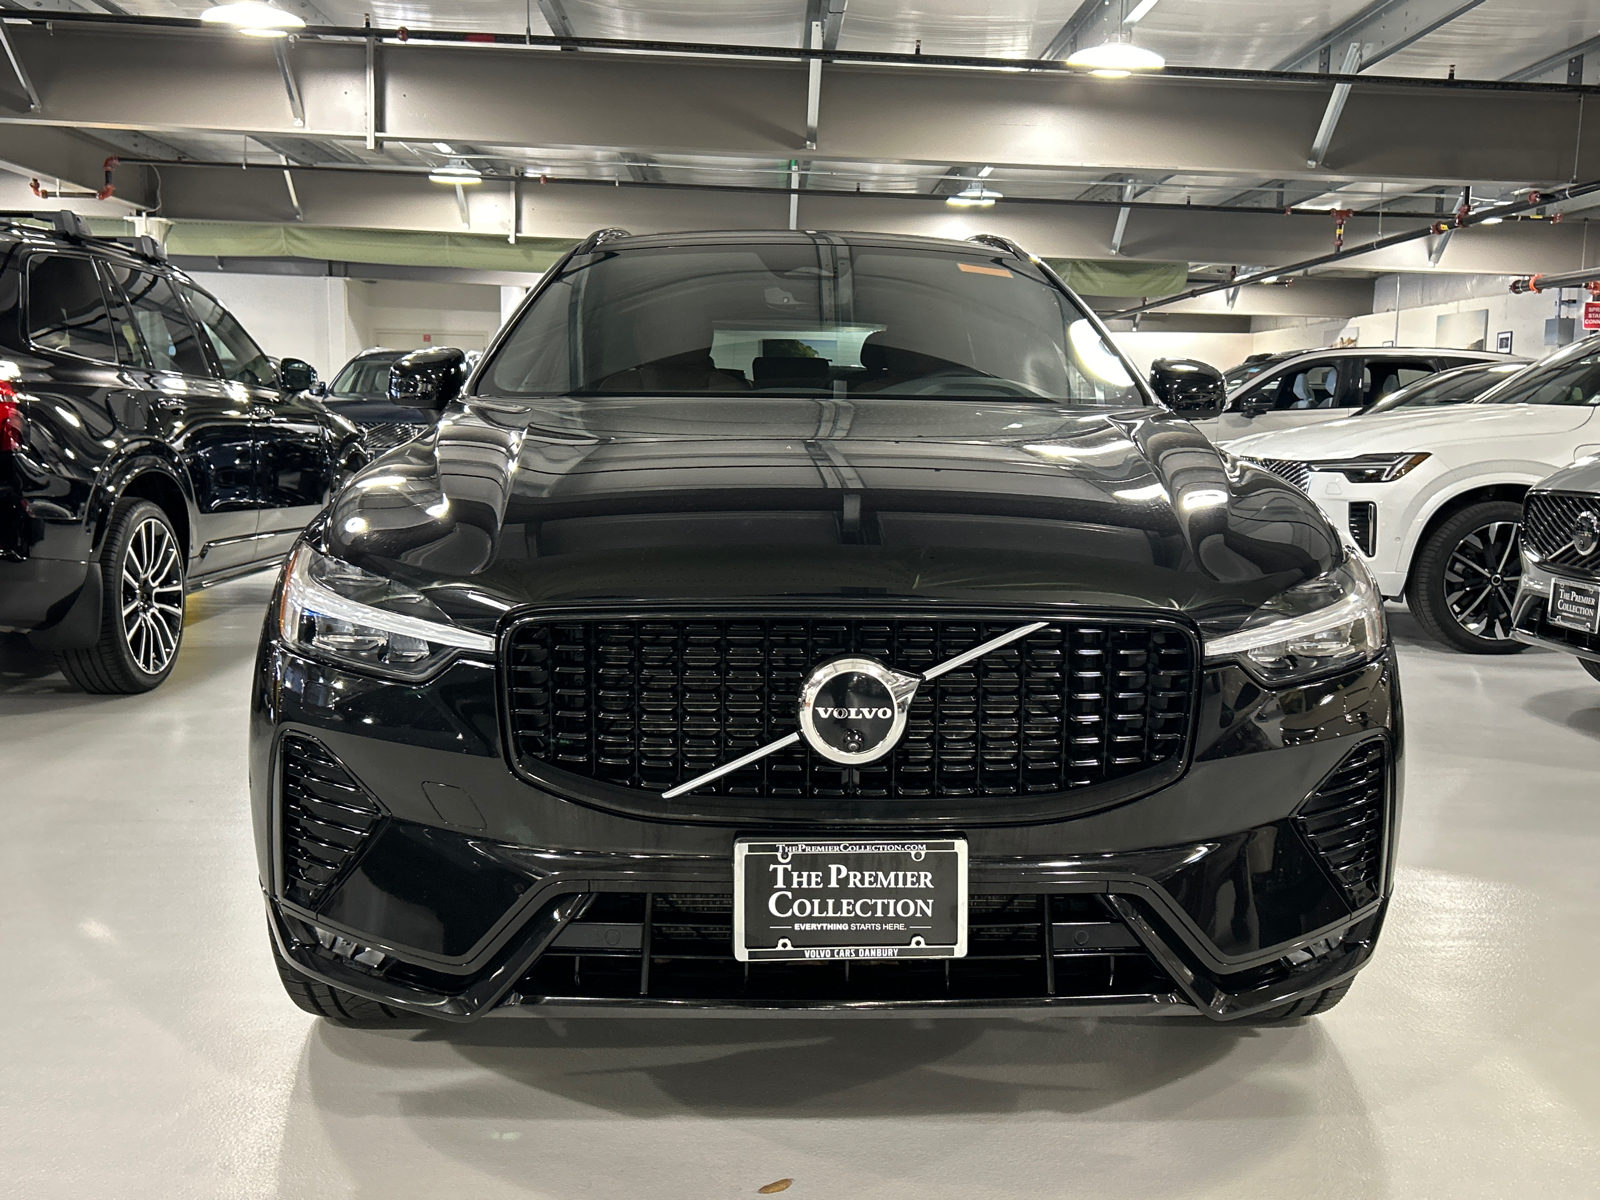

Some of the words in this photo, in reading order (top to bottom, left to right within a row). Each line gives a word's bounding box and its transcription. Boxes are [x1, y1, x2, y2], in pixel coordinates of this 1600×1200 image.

[1557, 599, 1595, 617] COLLECTION
[815, 706, 893, 719] VOLVO
[769, 863, 823, 889] THE
[827, 863, 934, 889] PREMIER
[768, 891, 934, 918] COLLECTION
[794, 923, 849, 931] EVERYTHING
[850, 923, 881, 931] STARTS
[882, 923, 908, 931] HERE.
[804, 949, 831, 958] VOLVO
[834, 949, 856, 958] CARS
[858, 948, 899, 958] DANBURY
